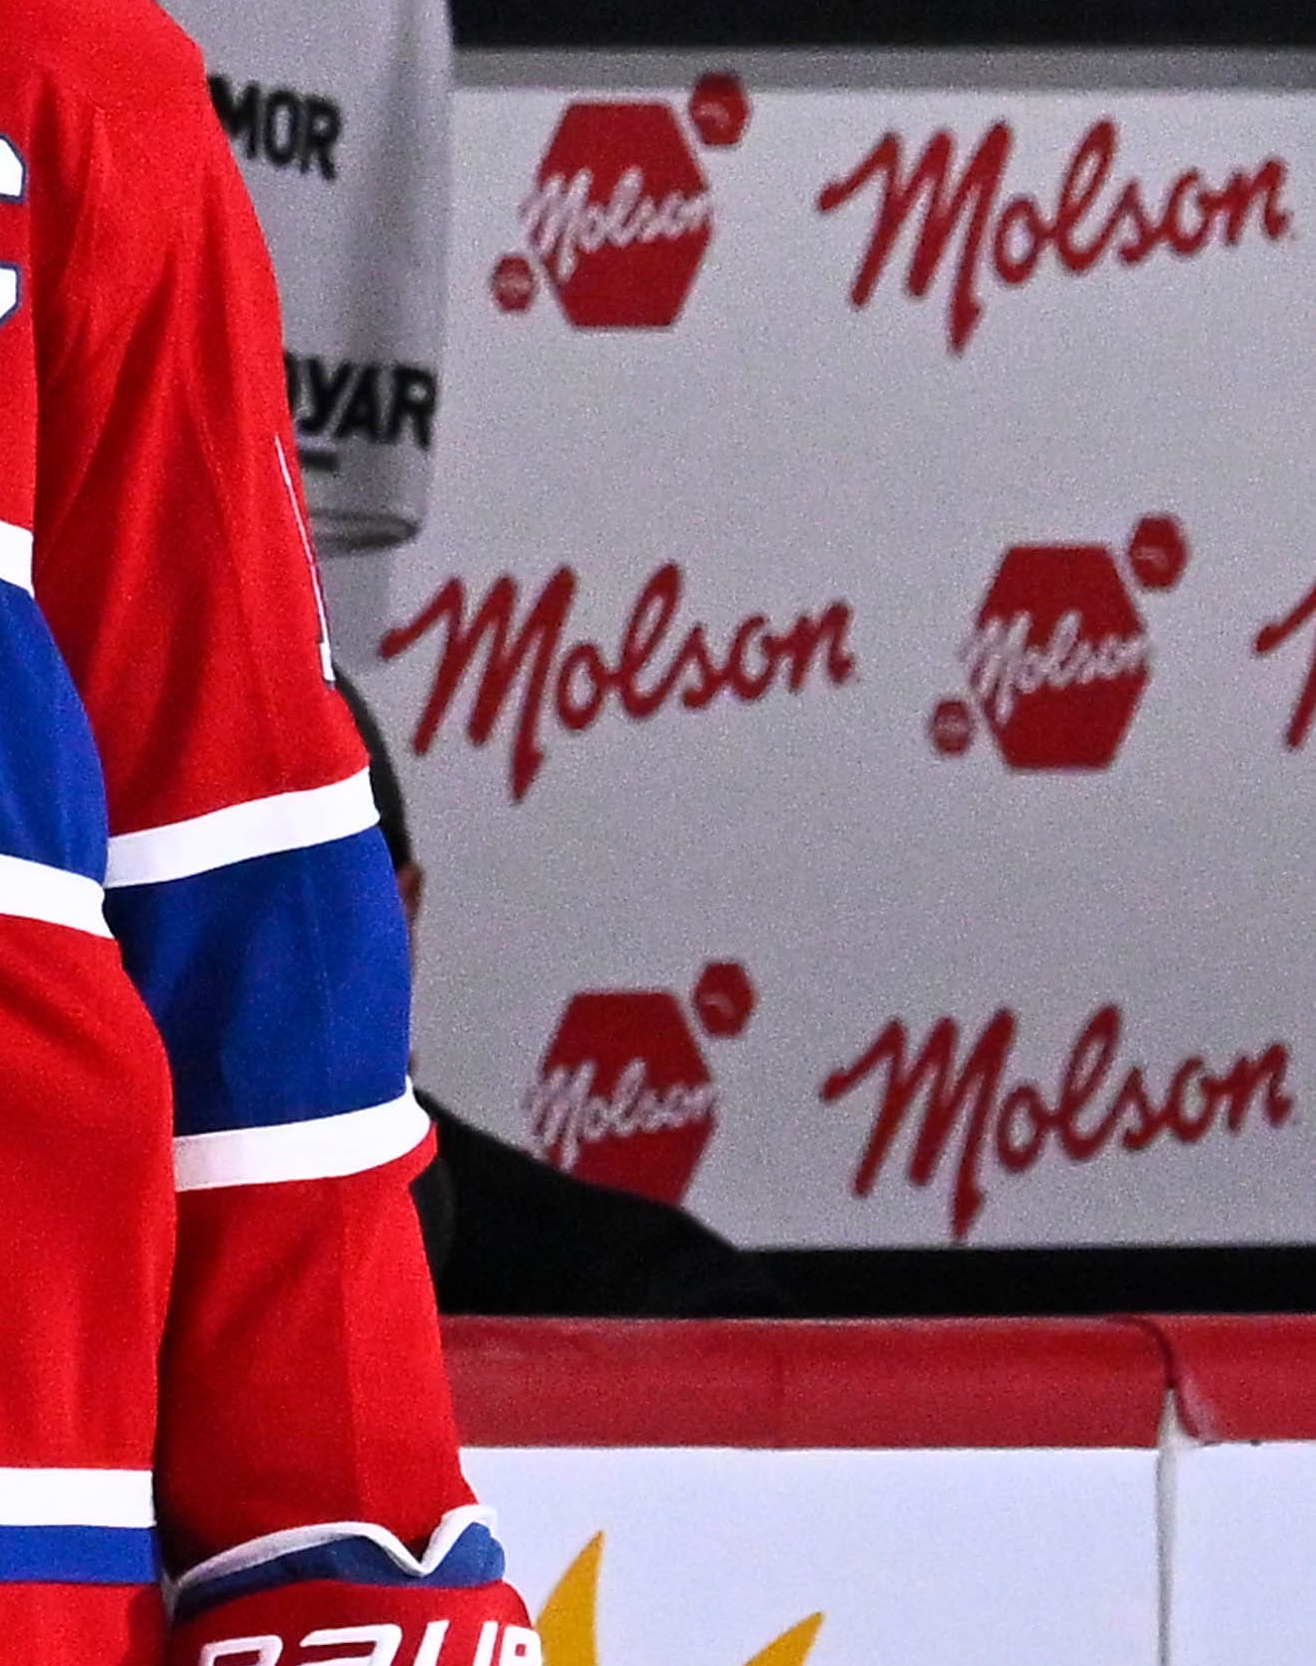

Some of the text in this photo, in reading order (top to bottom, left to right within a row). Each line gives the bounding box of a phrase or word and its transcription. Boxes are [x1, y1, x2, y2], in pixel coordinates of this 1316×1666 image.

[518, 165, 714, 283] Molson
[815, 118, 1291, 356] Molson
[379, 559, 855, 803] Molson
[958, 609, 1151, 726] Molson
[521, 1056, 719, 1172] Molson
[819, 1003, 1295, 1243] Molson
